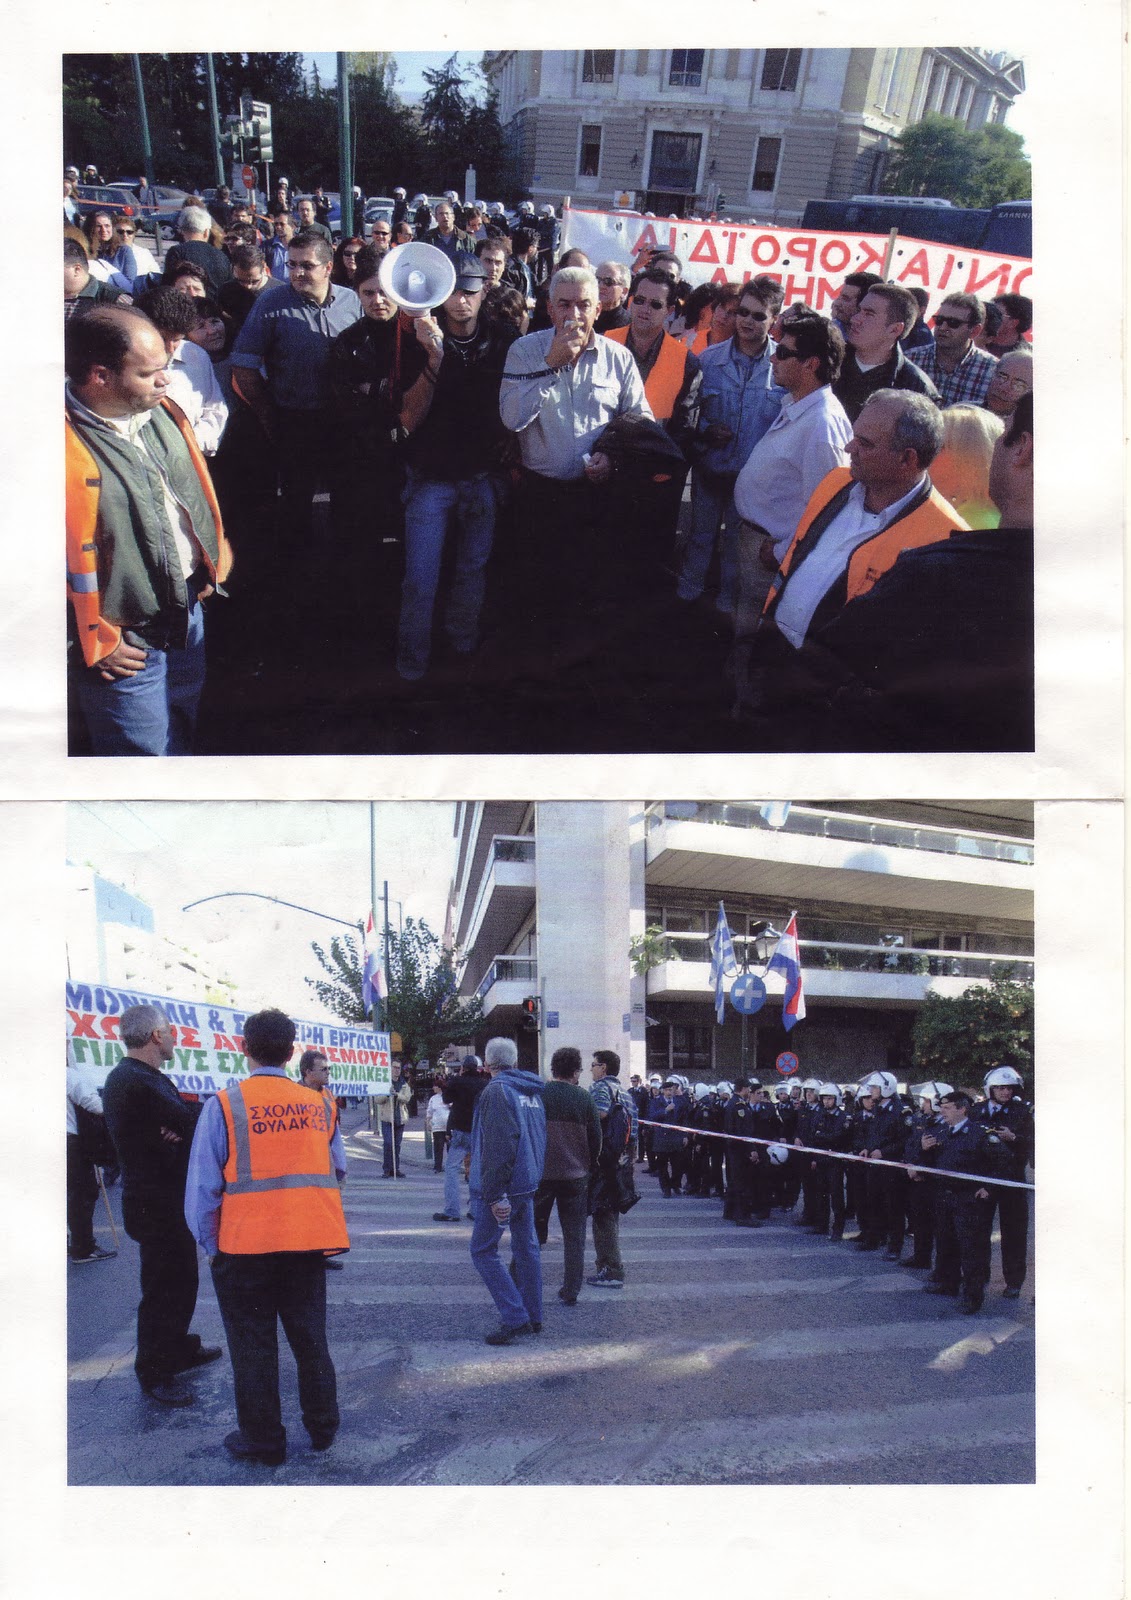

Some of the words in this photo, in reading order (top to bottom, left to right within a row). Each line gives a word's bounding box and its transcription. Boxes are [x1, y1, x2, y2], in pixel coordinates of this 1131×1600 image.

[66, 982, 200, 1028] ΜΟΜΗ
[208, 1009, 226, 1033] &
[329, 1029, 388, 1051] ΕΡΓΑΣΙΑ
[72, 1037, 124, 1067] ΓΙΑ
[323, 1083, 368, 1095] ΜΥΡΝΗΣ
[250, 1103, 325, 1120] ΣΧΟΛΙΚΟΣ
[252, 1116, 327, 1135] ΦΥΛΑΚΑΣ
